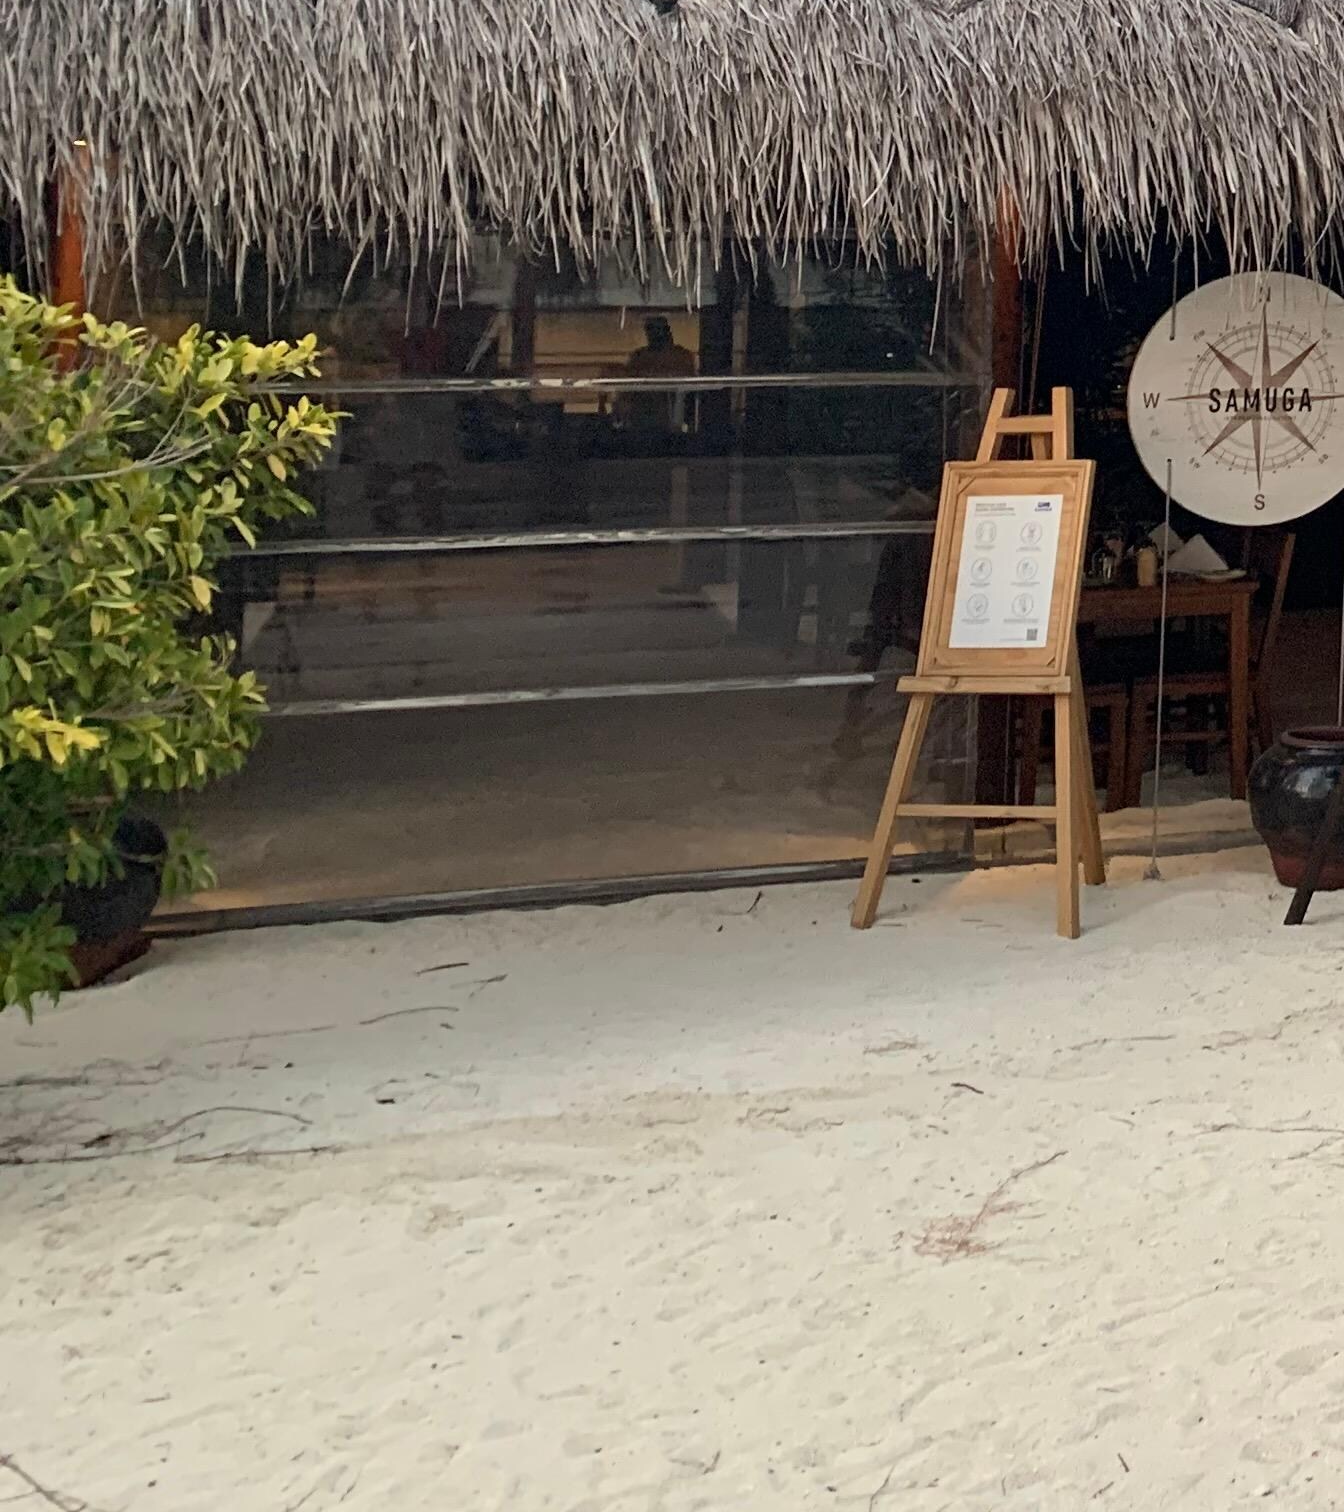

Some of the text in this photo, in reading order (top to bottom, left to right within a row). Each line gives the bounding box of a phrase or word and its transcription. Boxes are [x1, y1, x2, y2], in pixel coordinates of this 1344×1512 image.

[1143, 392, 1160, 408] W
[1209, 387, 1312, 413] SAMUGA
[1254, 493, 1265, 511] S
